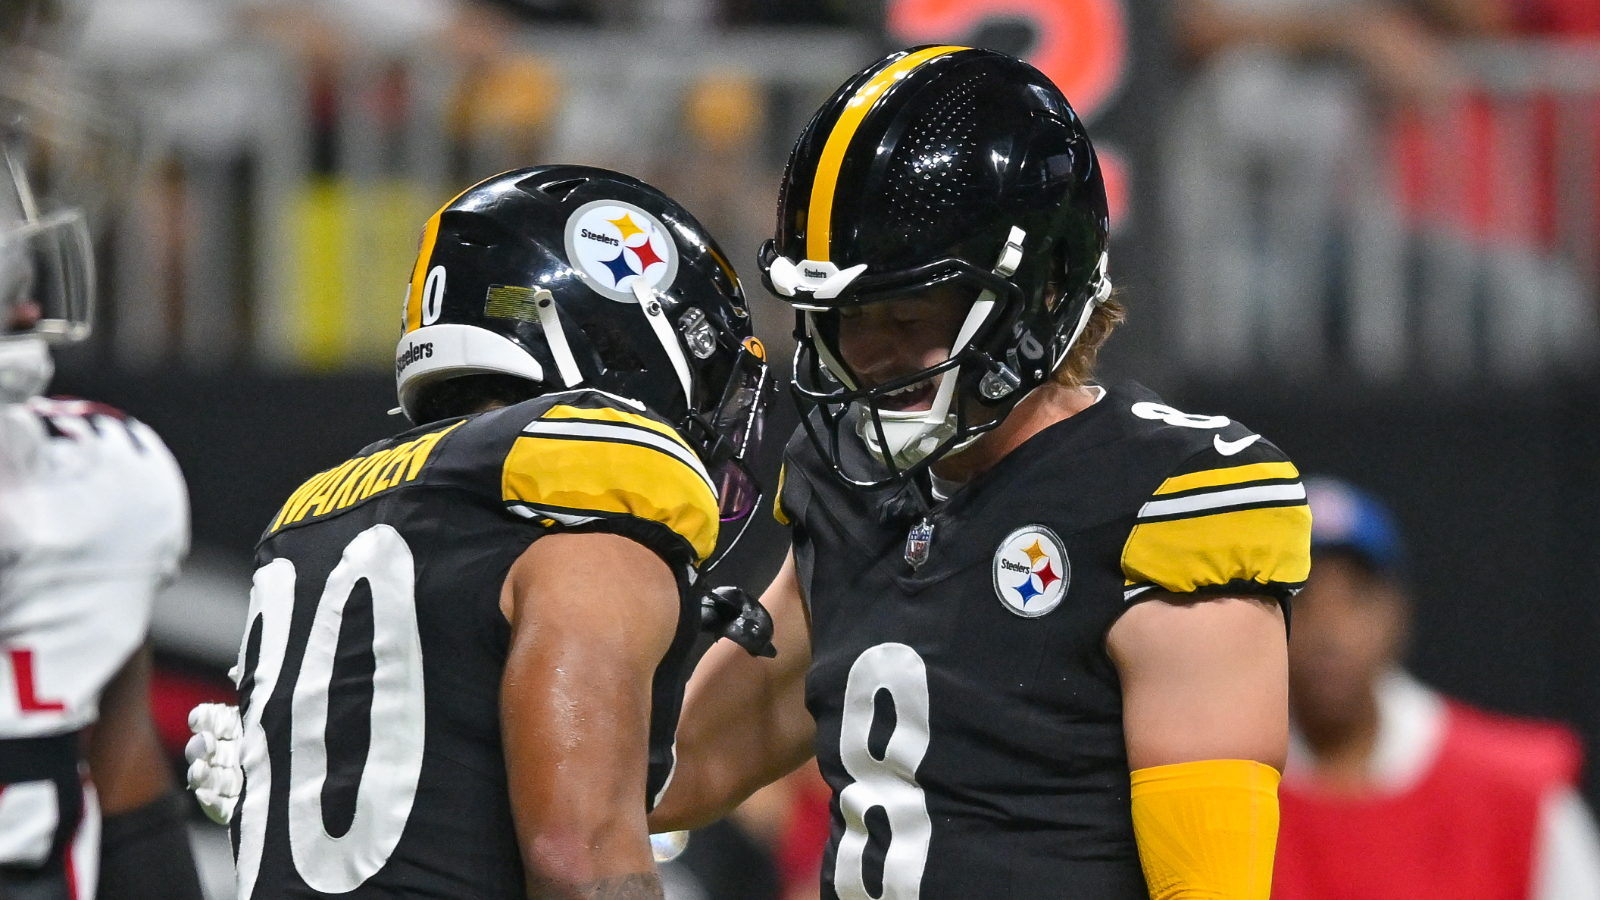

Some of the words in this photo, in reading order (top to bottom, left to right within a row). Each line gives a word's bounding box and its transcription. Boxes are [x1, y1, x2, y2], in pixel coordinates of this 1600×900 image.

[581, 228, 619, 247] Steelers
[804, 267, 827, 279] Steelers
[397, 341, 433, 377] eelers
[1131, 402, 1230, 429] 8
[270, 419, 467, 533] WARREN
[1001, 558, 1030, 575] Steelers
[834, 642, 932, 900] 8
